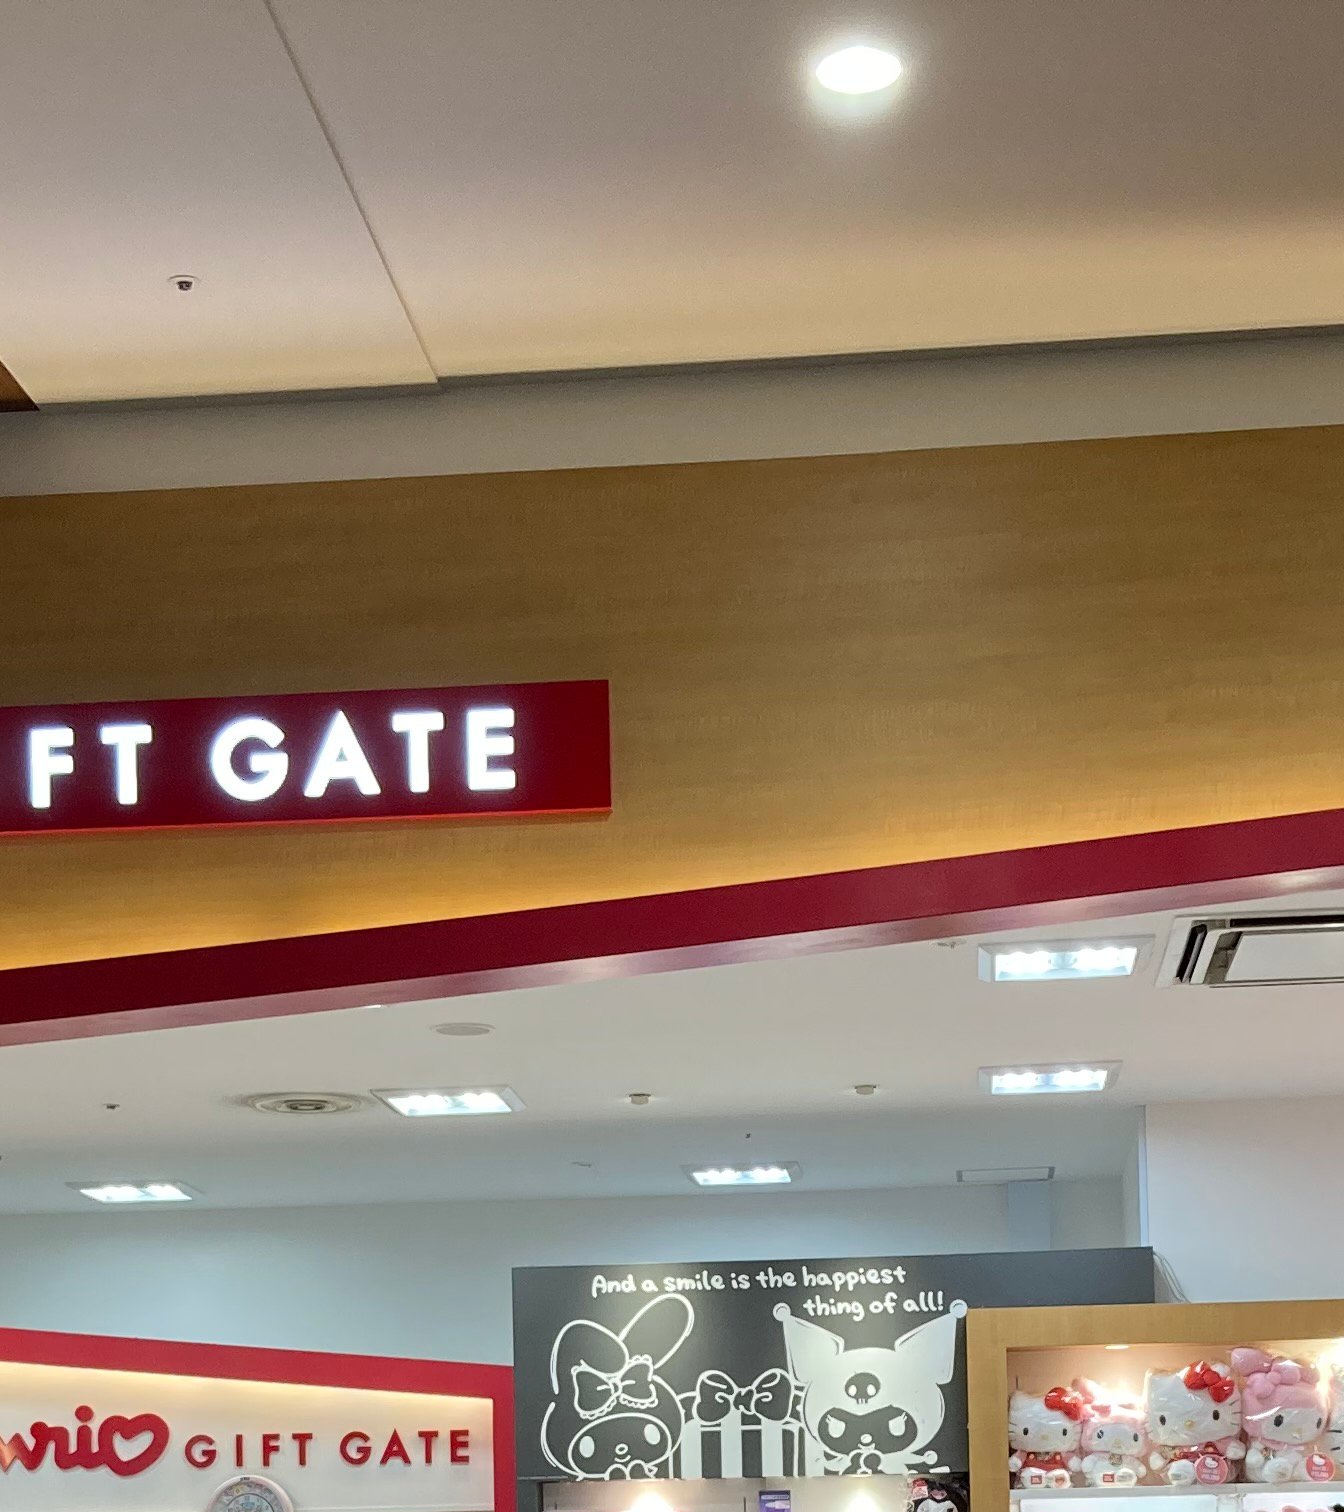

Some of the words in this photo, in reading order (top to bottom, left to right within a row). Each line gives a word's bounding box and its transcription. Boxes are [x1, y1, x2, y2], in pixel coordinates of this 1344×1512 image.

[210, 707, 517, 802] GATE
[591, 1274, 636, 1298] And
[641, 1277, 658, 1292] a
[664, 1269, 725, 1293] smile
[731, 1272, 750, 1290] is
[756, 1266, 797, 1289] the
[802, 1265, 906, 1291] happiest
[803, 1294, 865, 1321] thing
[869, 1291, 898, 1314] of
[903, 1290, 944, 1312] all!
[184, 1432, 314, 1470] GIFT
[339, 1429, 470, 1467] GATE
